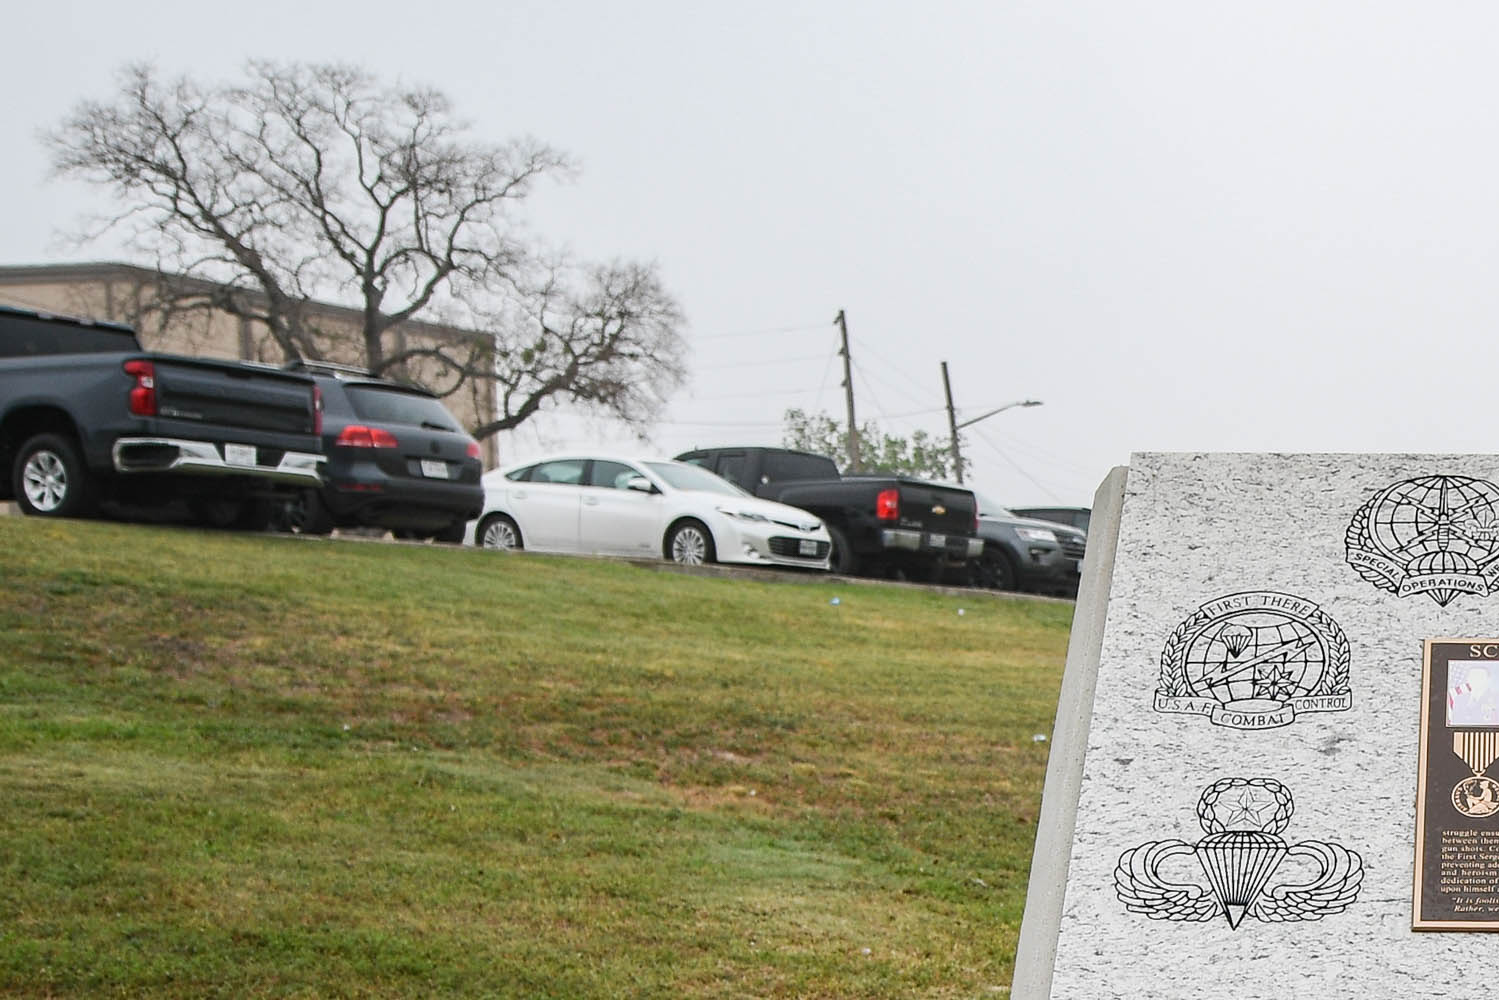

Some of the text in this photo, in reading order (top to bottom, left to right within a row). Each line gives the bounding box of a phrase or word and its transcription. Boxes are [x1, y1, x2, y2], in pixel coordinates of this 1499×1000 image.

[1354, 553, 1400, 580] SPECIAL
[1402, 578, 1484, 593] OPERATIONS
[1208, 595, 1311, 616] FIRST THERE
[1220, 713, 1288, 727] COMBAT
[1295, 697, 1347, 709] CONTROL
[1442, 829, 1478, 838] struggle
[1441, 861, 1486, 869] preventing
[1440, 877, 1486, 885] dedication
[1489, 877, 1499, 885] of
